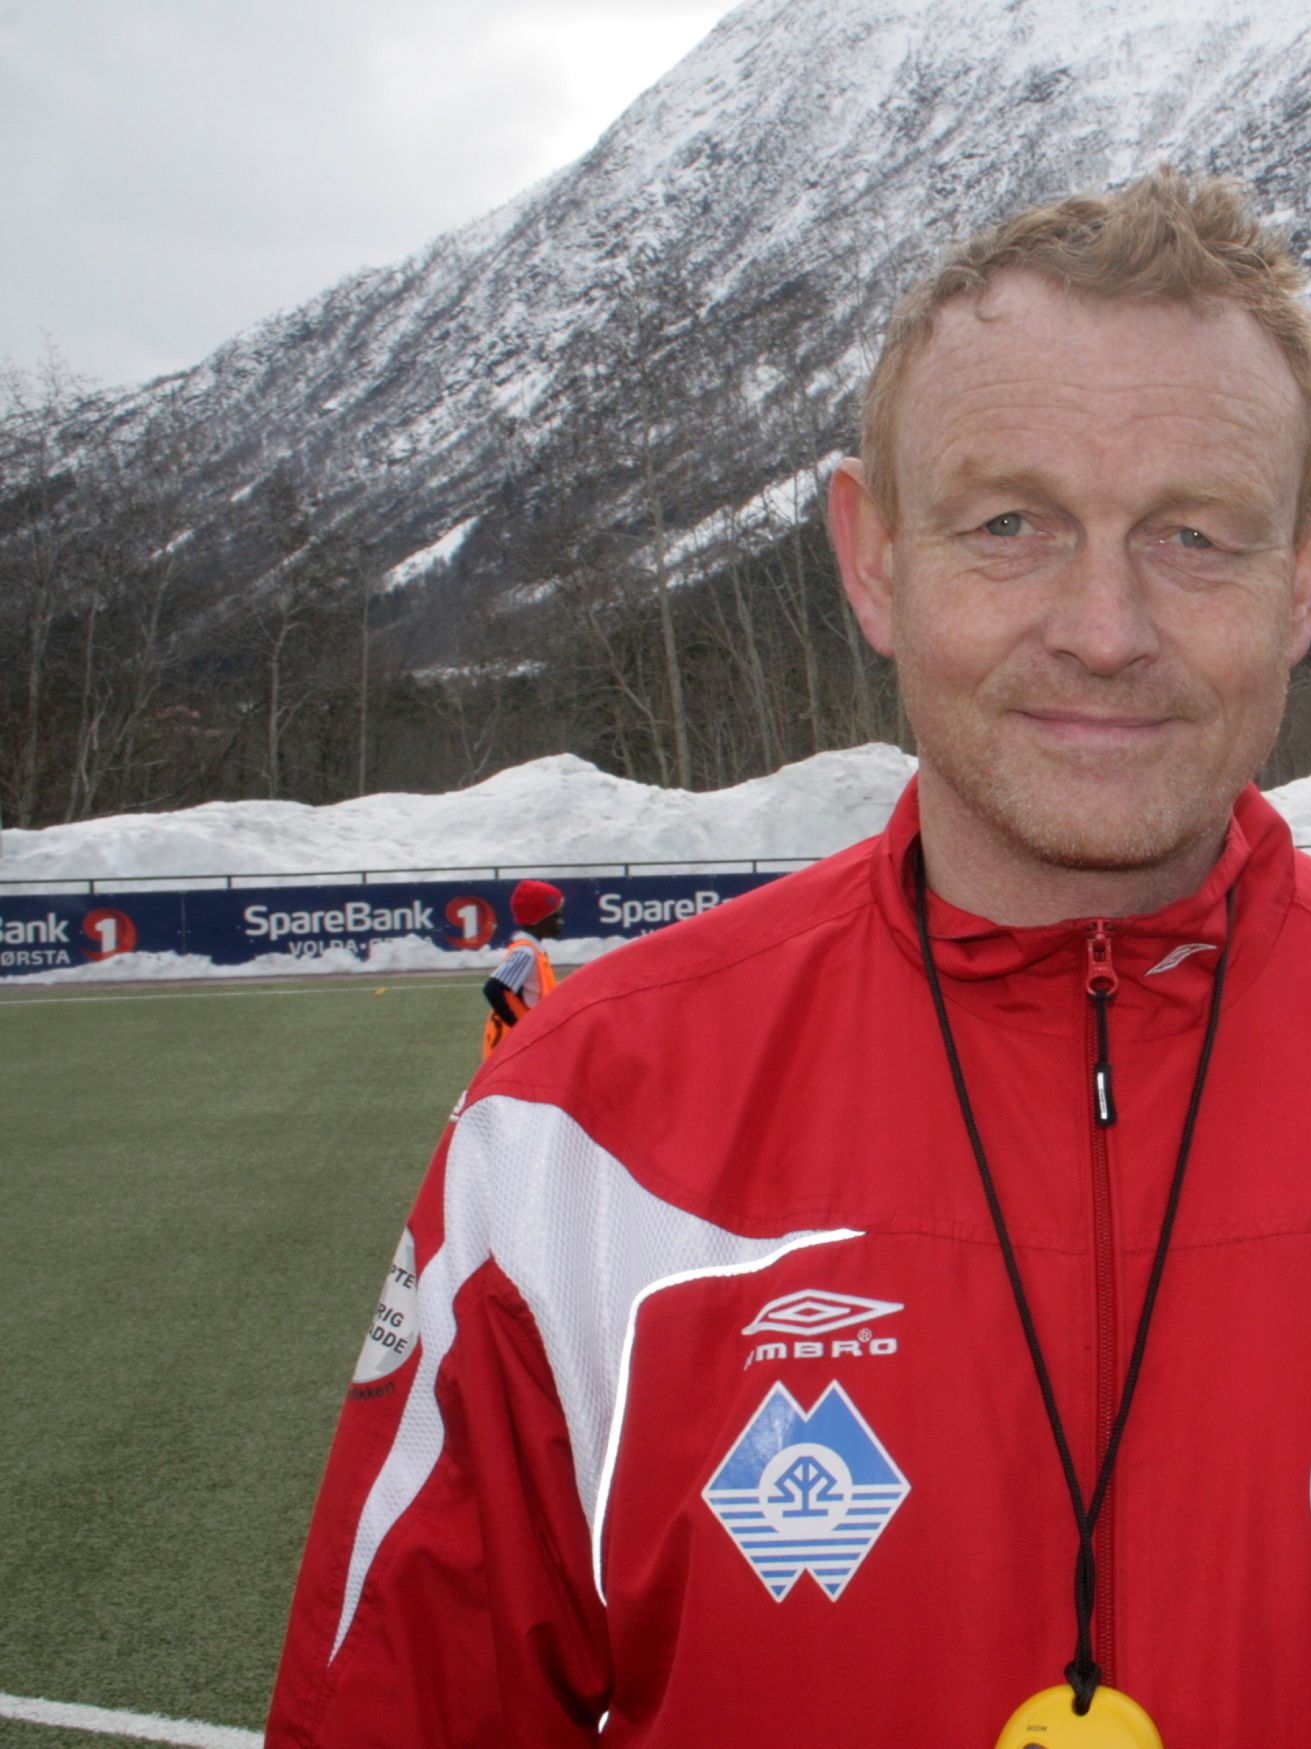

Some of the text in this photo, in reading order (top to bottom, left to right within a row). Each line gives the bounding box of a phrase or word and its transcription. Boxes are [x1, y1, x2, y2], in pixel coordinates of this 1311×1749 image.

[244, 899, 479, 941] SpareBank 1
[599, 891, 733, 928] SpareB
[0, 912, 117, 953] ank 1
